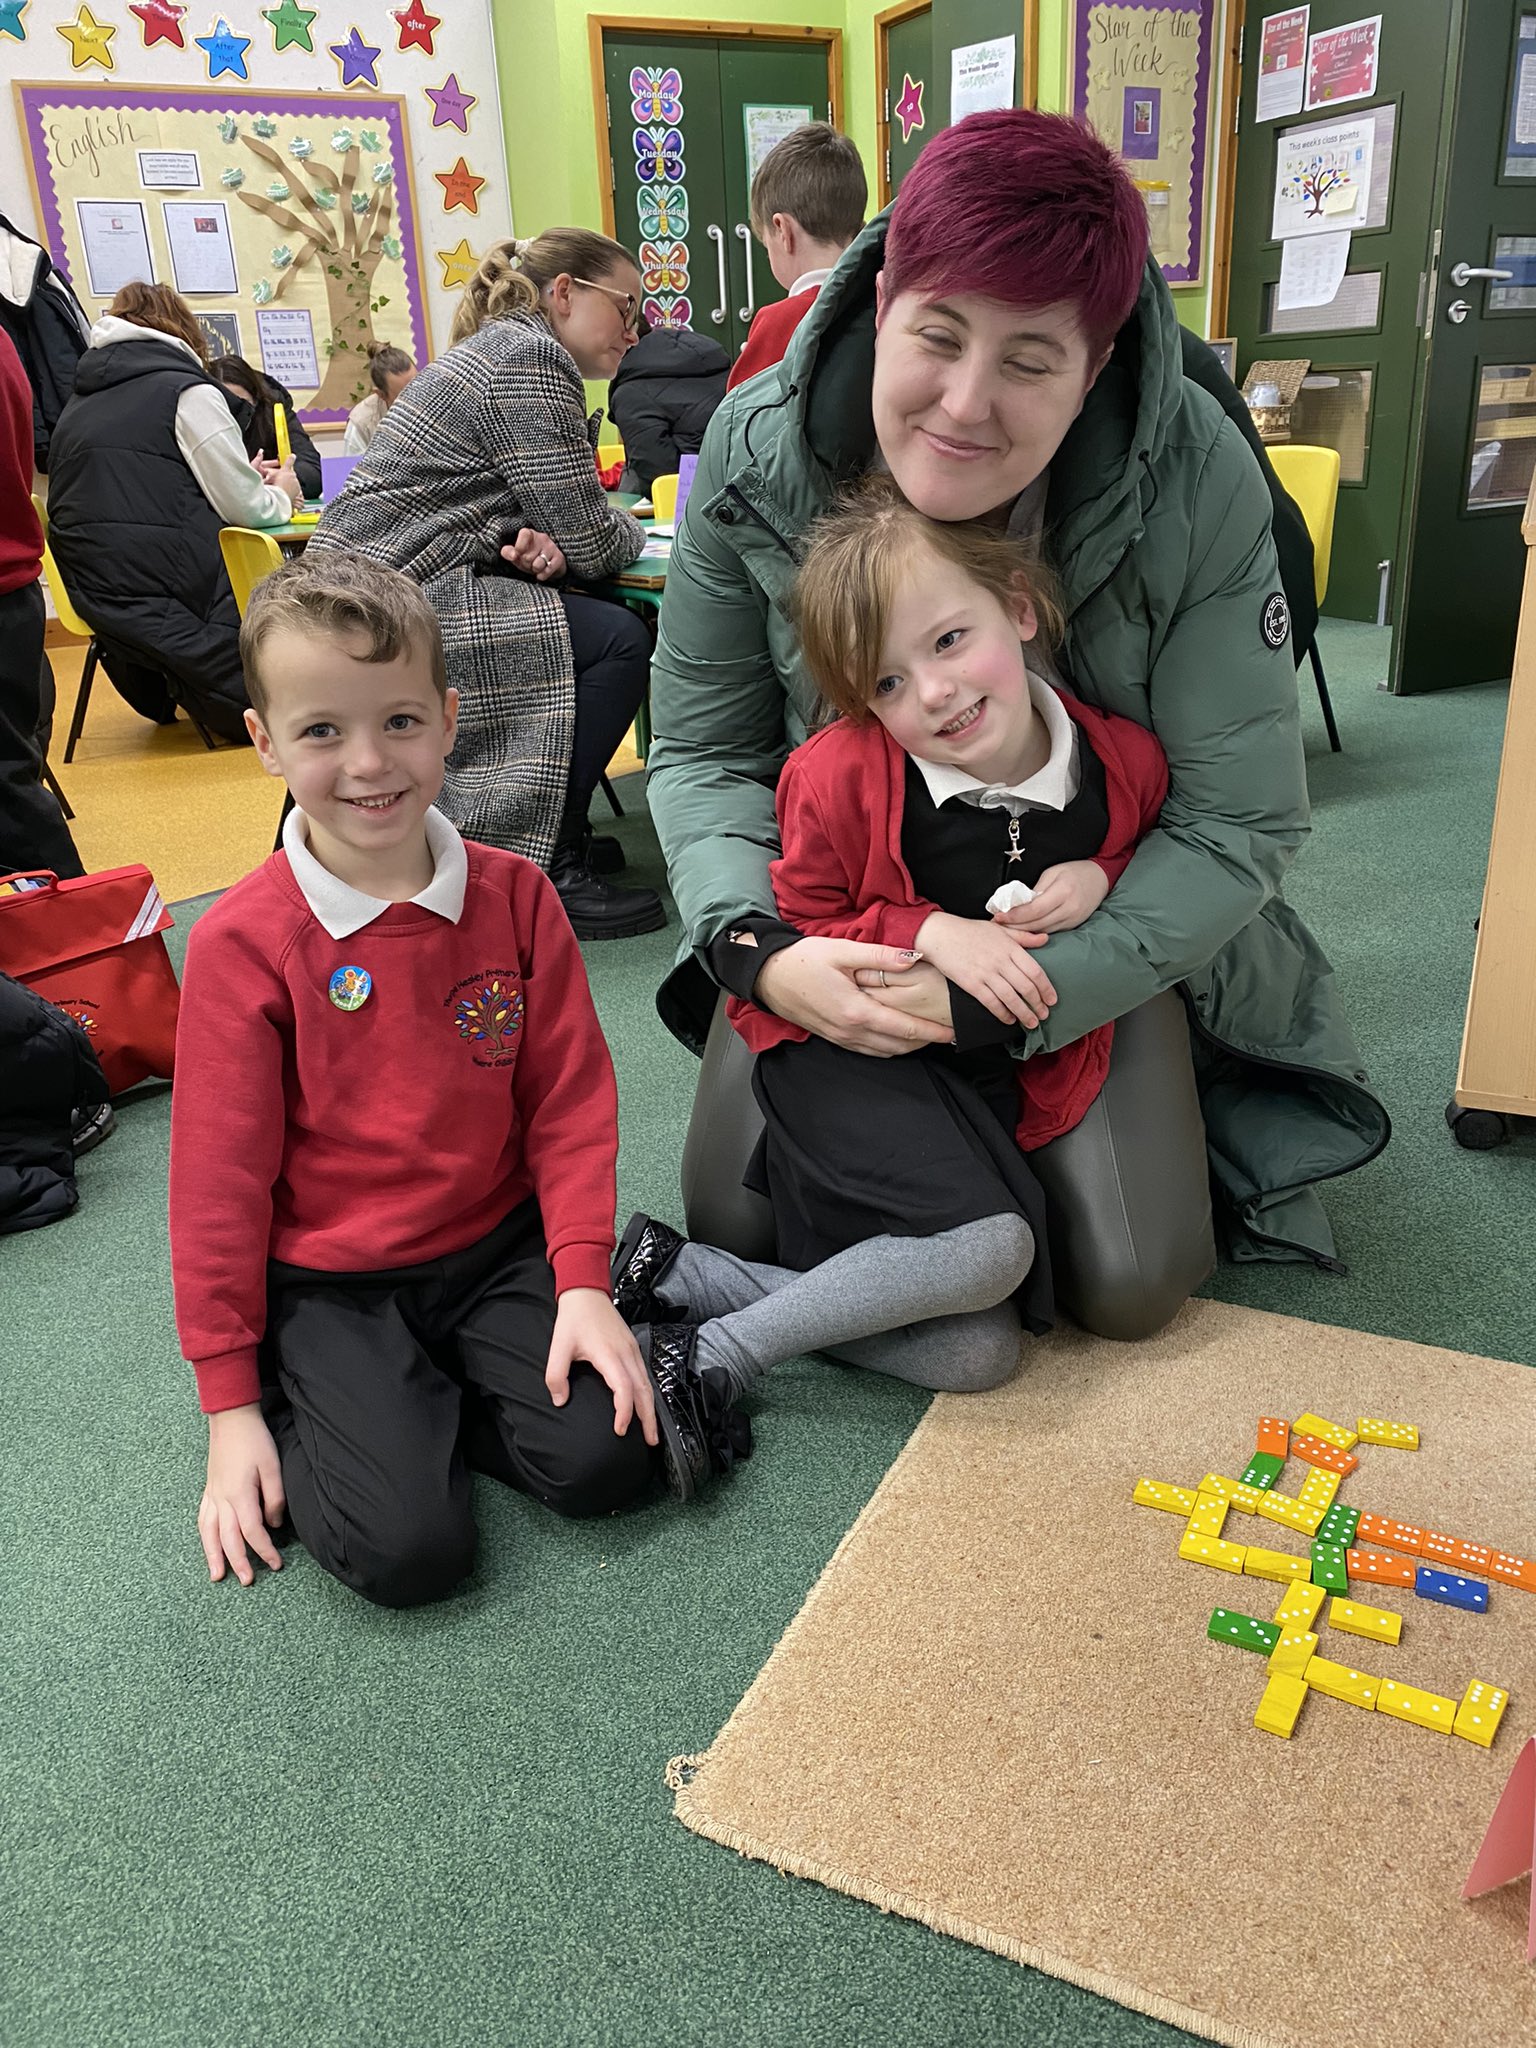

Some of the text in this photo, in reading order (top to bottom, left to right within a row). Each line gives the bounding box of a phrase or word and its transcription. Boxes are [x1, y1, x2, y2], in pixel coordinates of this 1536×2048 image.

[280, 17, 302, 29] Finally
[407, 19, 426, 31] after
[1094, 12, 1196, 43] Star of the
[79, 35, 98, 43] Next
[1315, 41, 1330, 54] Star
[1330, 34, 1339, 55] of
[1338, 32, 1349, 48] the
[1113, 43, 1178, 77] Week
[639, 89, 674, 102] Monday
[50, 113, 152, 178] English
[1289, 131, 1360, 151] This week's class points
[641, 148, 678, 160] Tuesday
[640, 207, 686, 219] Wednesday
[645, 261, 685, 272] Thursday
[654, 316, 682, 327] Friday
[486, 969, 519, 980] Primary
